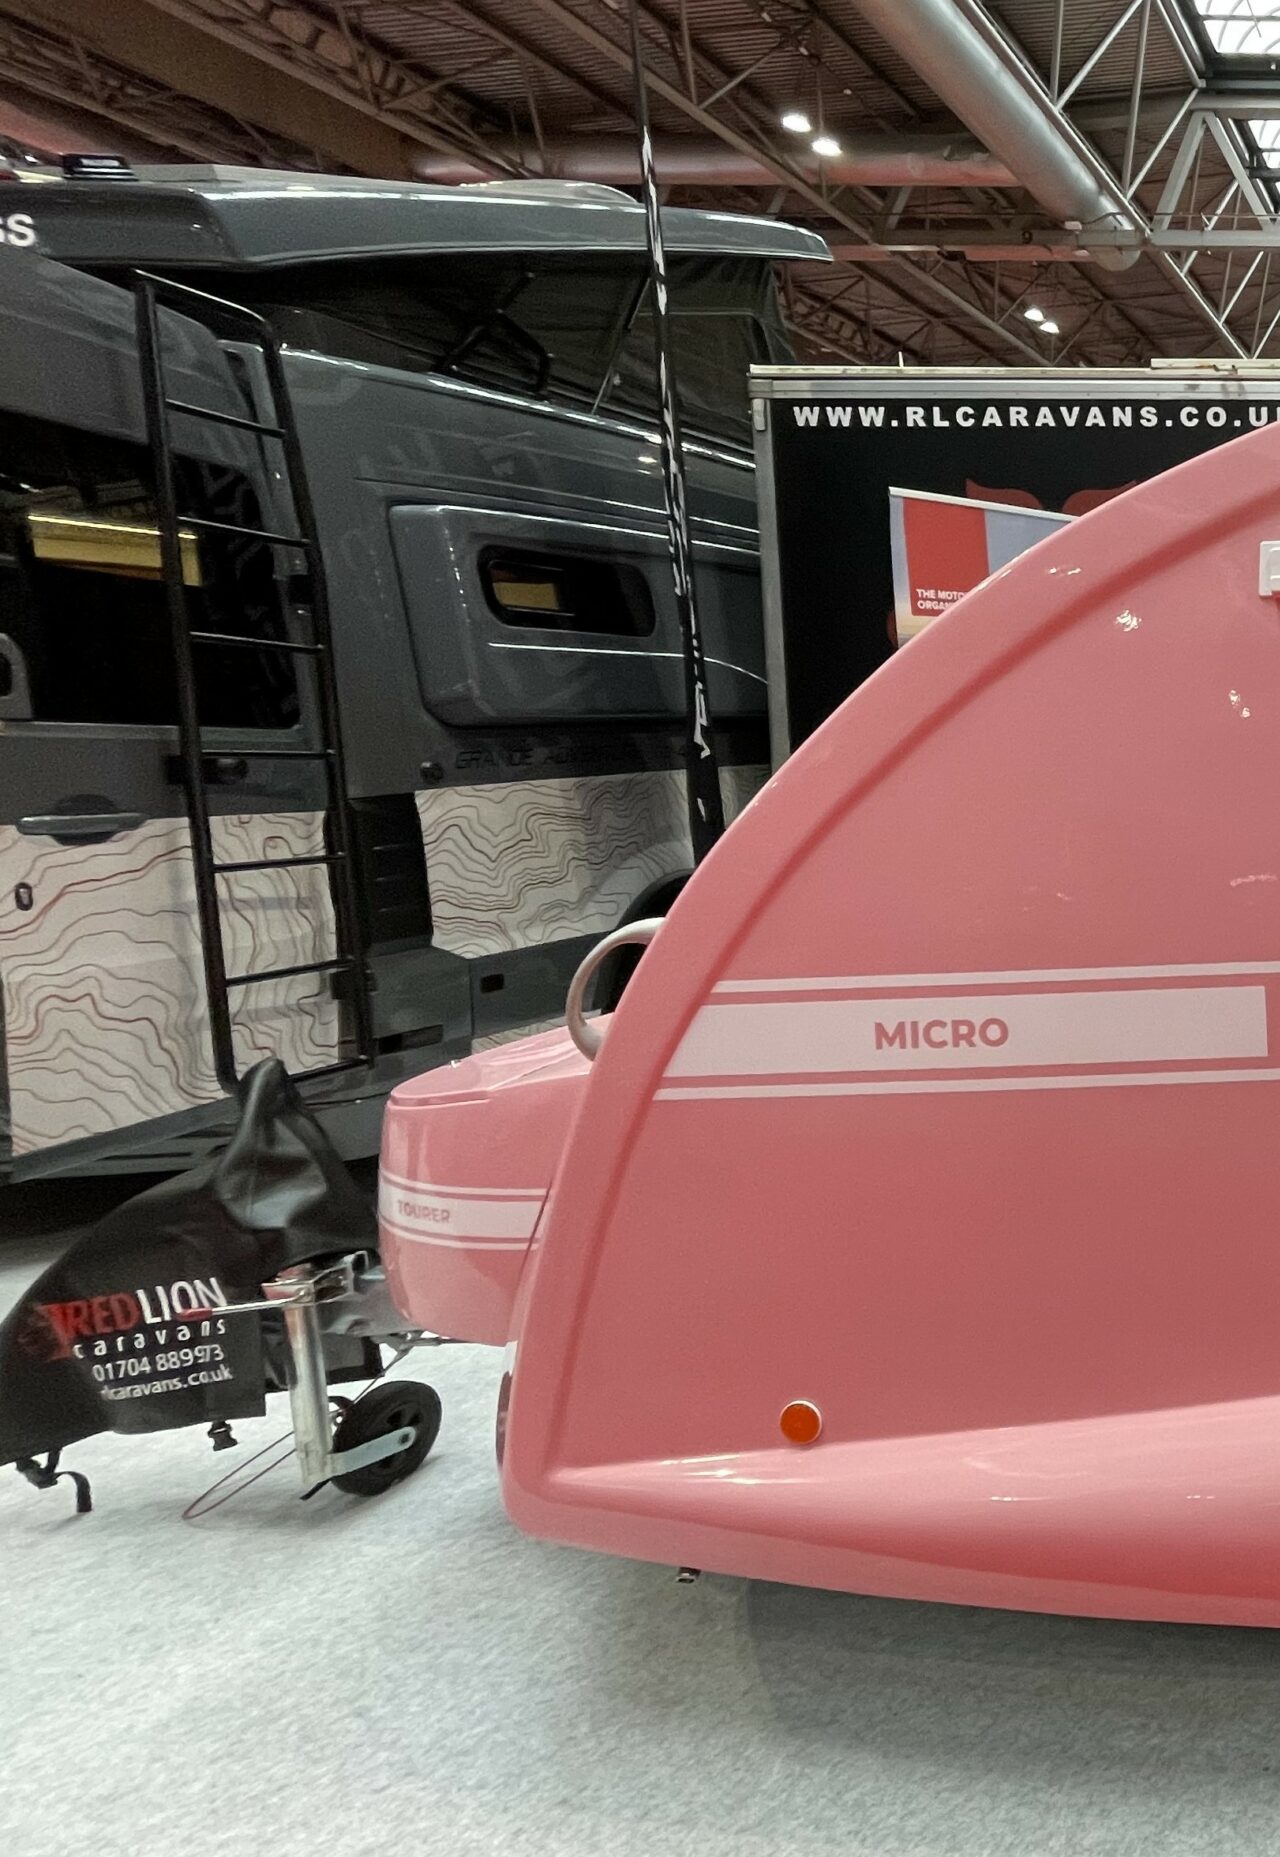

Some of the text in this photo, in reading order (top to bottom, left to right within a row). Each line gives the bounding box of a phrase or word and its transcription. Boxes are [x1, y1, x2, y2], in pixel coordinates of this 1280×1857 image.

[916, 589, 936, 599] THE
[874, 1017, 1009, 1050] MICRO
[398, 1201, 450, 1223] TOURER
[92, 1343, 225, 1382] 01704 889973
